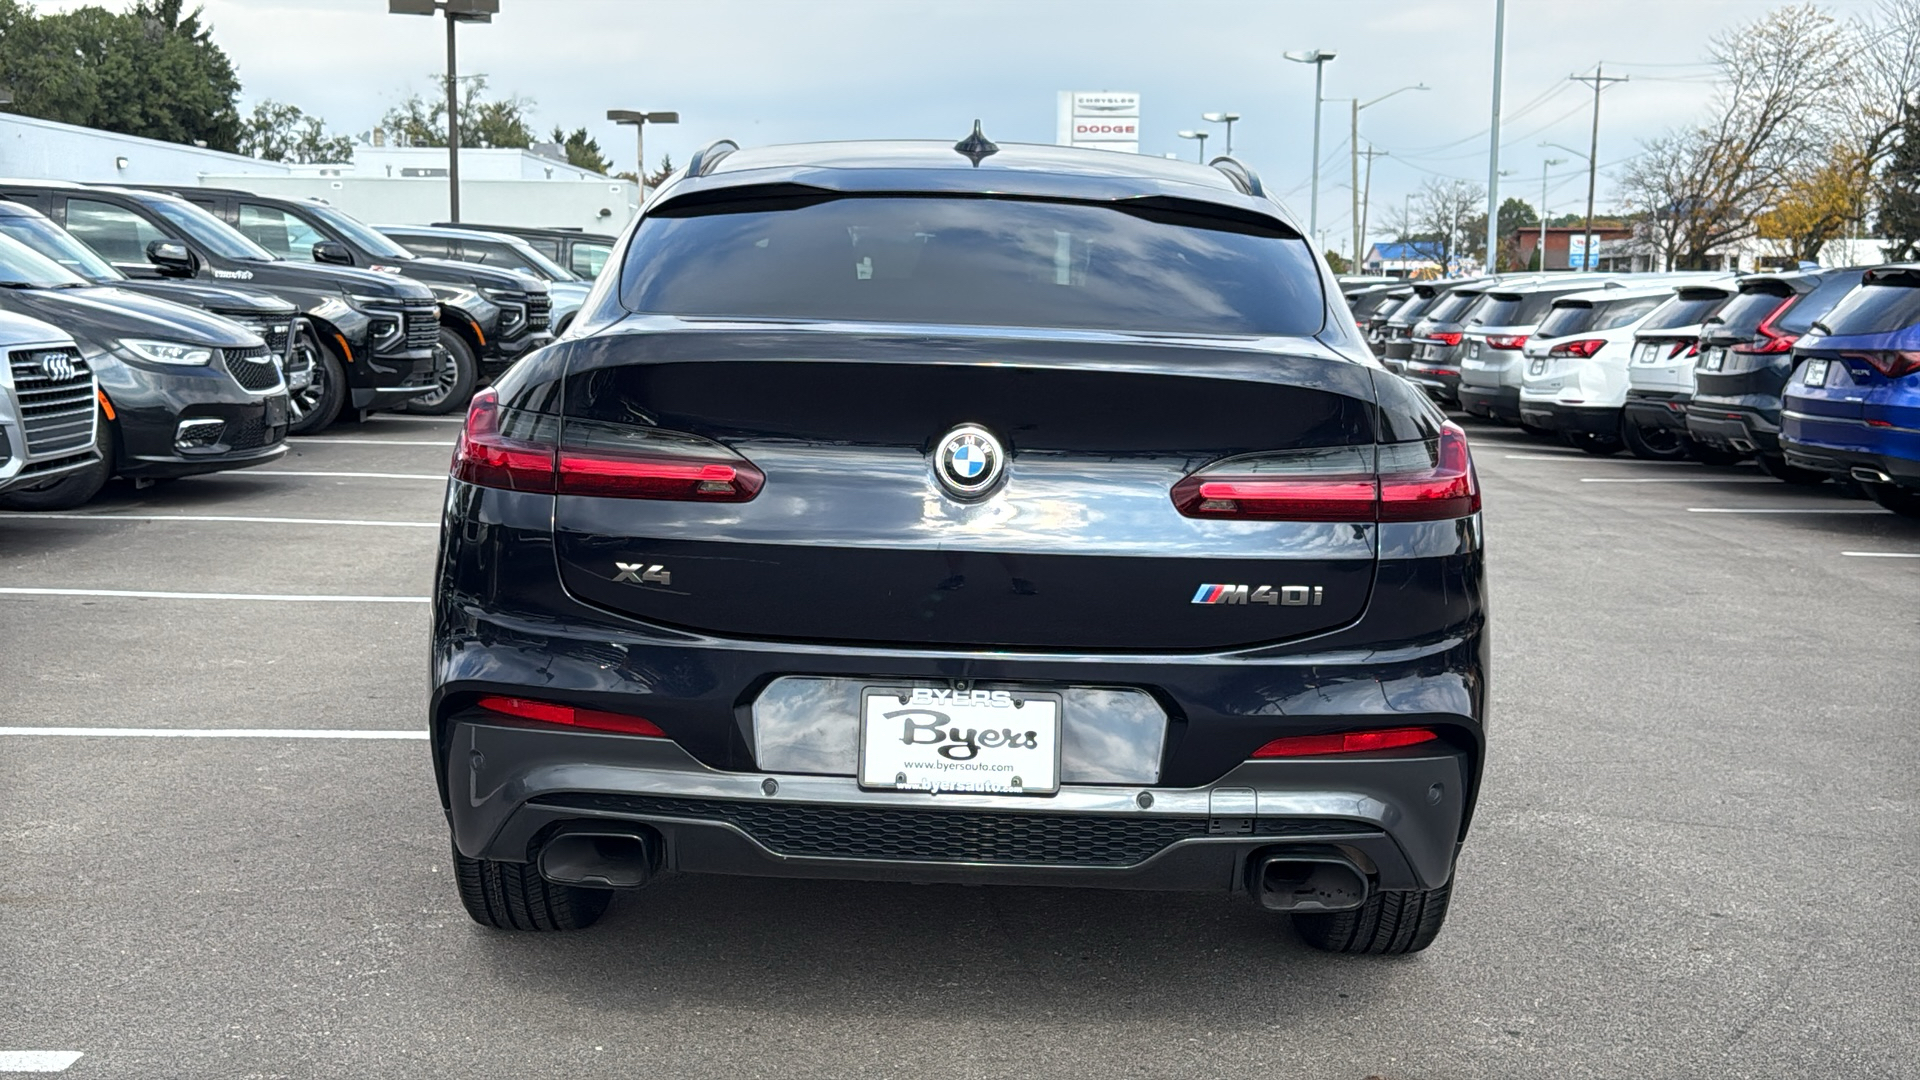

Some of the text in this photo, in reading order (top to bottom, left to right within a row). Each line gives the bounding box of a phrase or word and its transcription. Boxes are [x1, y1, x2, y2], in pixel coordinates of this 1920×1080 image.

[1077, 125, 1135, 133] DODGE
[948, 435, 993, 454] BMW
[611, 562, 671, 585] X4
[1212, 584, 1323, 606] M40i
[912, 688, 1011, 708] BYERS
[882, 709, 1038, 761] Byers
[904, 760, 1014, 772] www.byersauto.com
